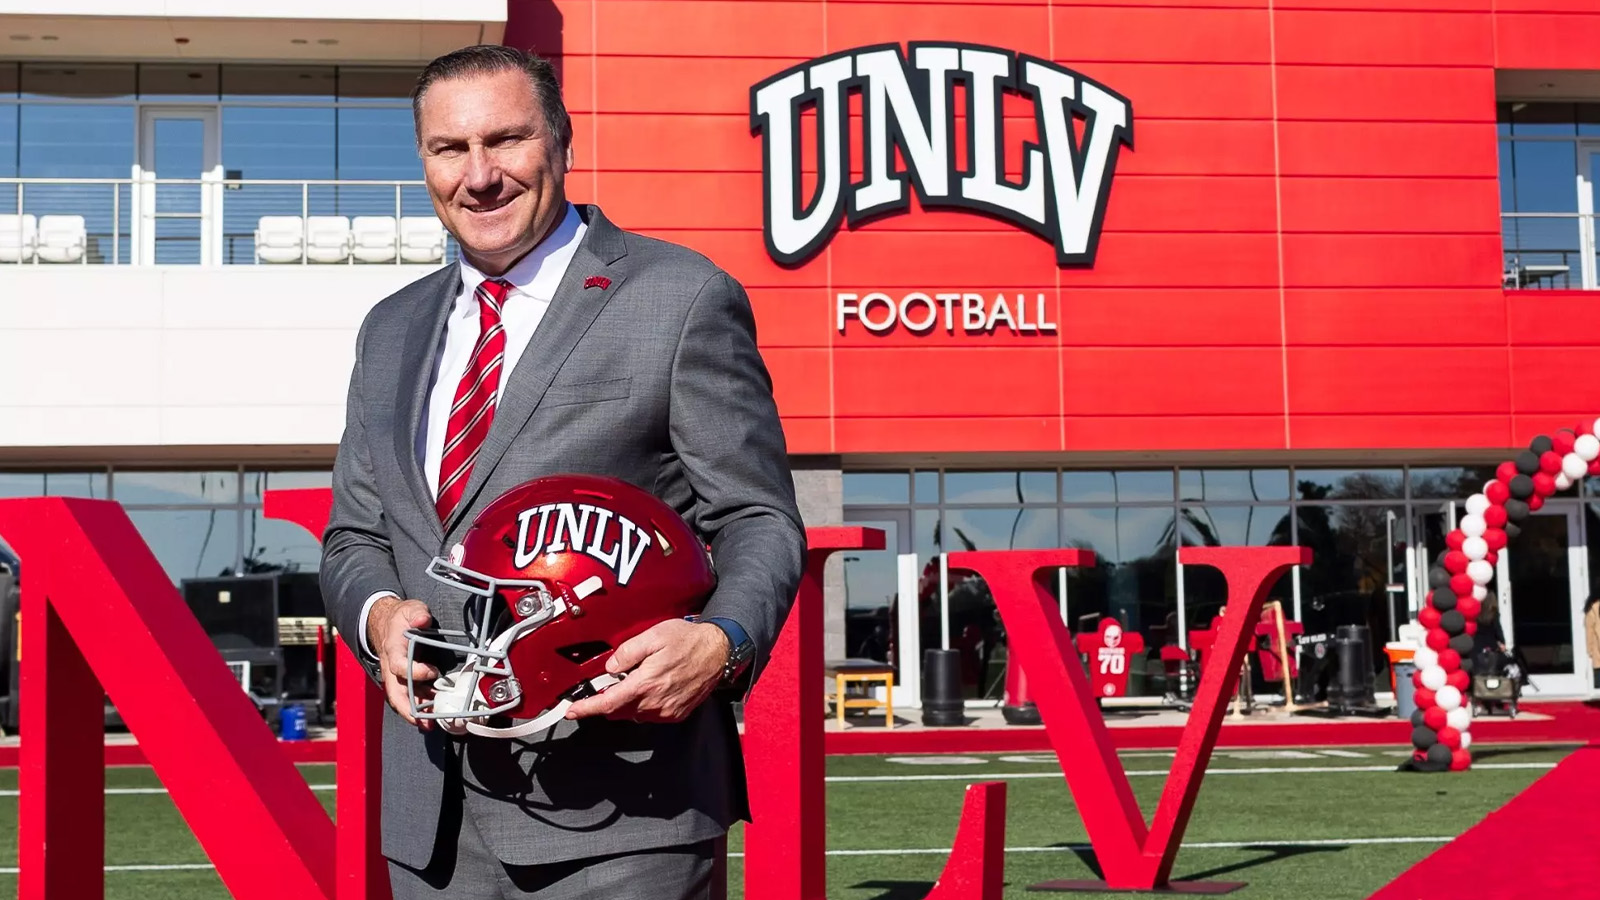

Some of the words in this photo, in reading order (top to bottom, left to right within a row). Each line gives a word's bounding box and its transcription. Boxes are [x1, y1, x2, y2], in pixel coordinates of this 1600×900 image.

[753, 42, 1131, 263] UNLV
[836, 292, 1058, 332] FOOTBALL
[513, 502, 651, 586] UNLV
[1098, 654, 1125, 675] 70
